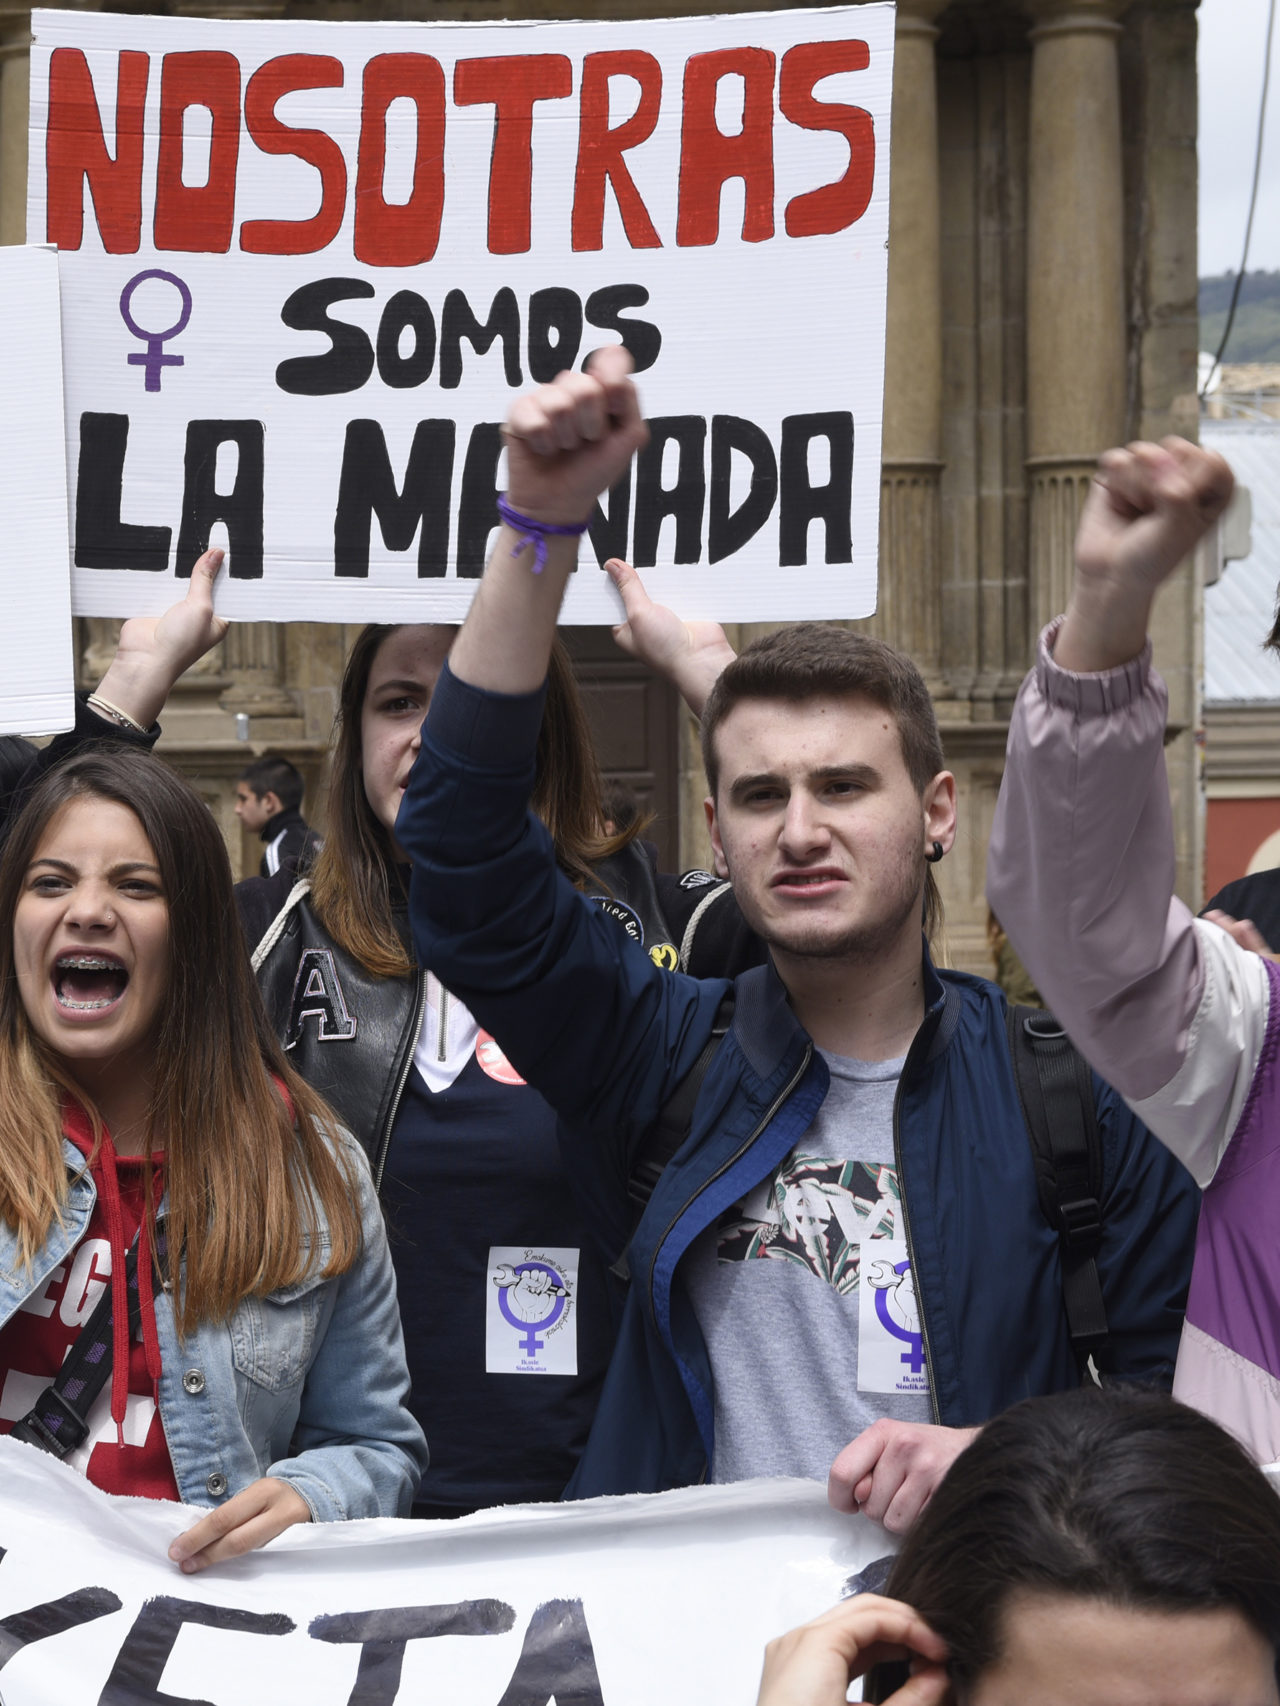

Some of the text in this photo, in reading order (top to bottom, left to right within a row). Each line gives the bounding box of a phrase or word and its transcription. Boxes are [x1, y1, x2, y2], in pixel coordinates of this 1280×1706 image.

[45, 38, 876, 267] NOSOTRAS
[275, 276, 662, 396] SOMOS
[74, 411, 265, 580] LA
[282, 948, 358, 1052] A
